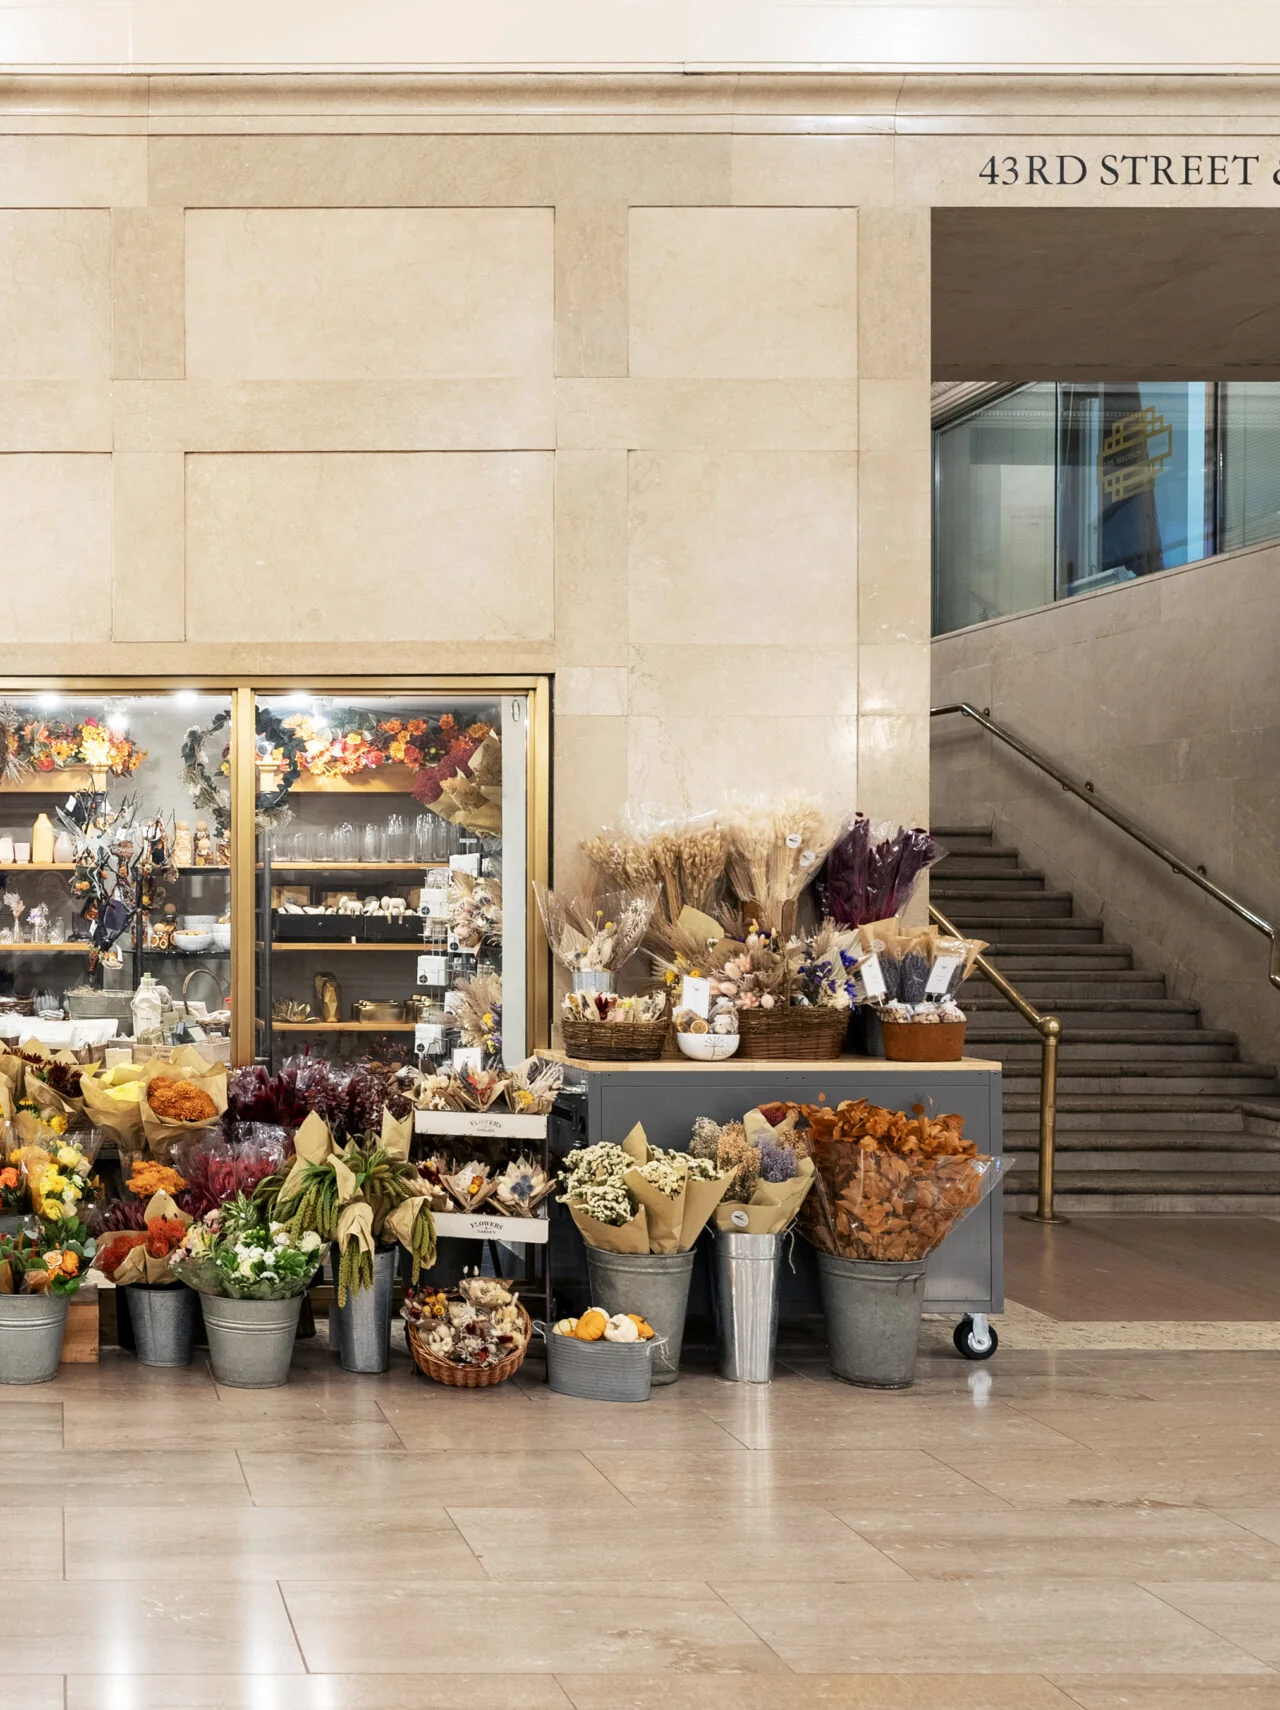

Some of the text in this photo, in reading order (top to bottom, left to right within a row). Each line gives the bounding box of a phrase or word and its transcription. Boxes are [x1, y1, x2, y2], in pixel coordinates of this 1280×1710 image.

[979, 156, 1087, 185] 43RD
[1100, 155, 1260, 185] STREET
[470, 1220, 504, 1230] FLOWERS
